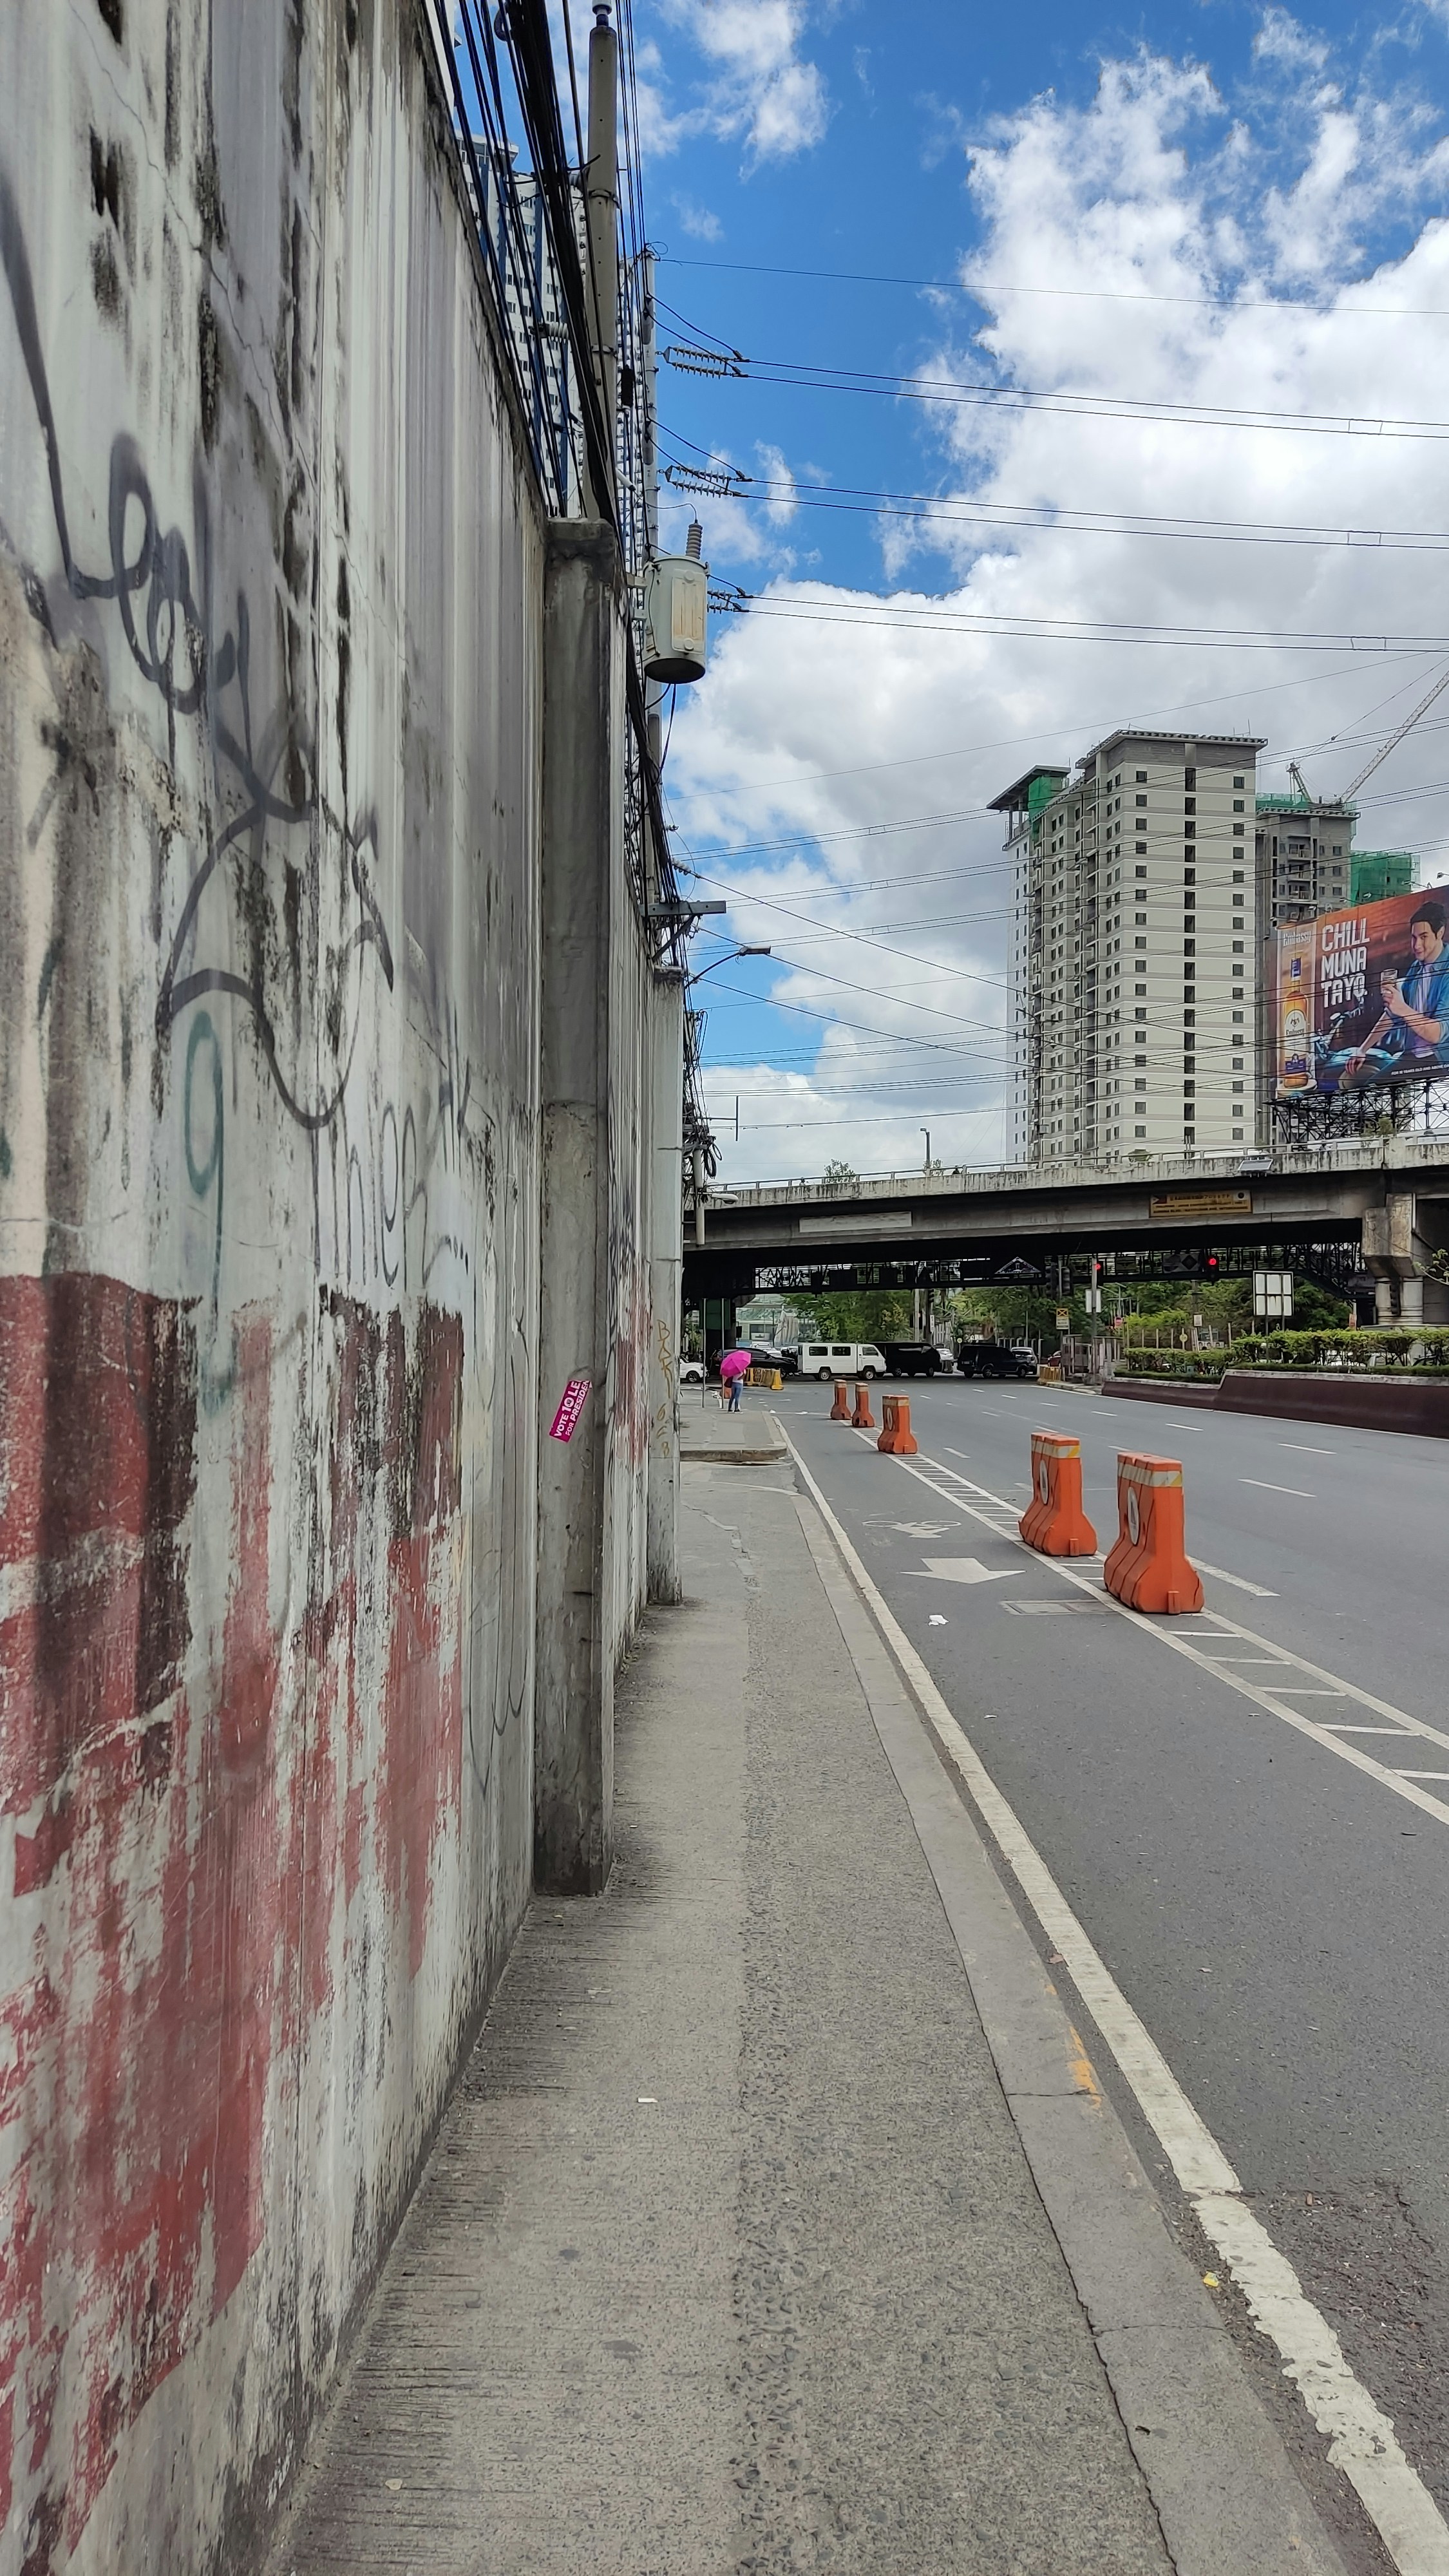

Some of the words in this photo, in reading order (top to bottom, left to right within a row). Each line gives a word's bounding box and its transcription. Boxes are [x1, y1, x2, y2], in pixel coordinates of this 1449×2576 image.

[1283, 930, 1311, 947] Embassy
[1321, 918, 1370, 951] CHILL
[1321, 946, 1367, 981] MUNA
[567, 1380, 582, 1397] LE
[562, 1397, 574, 1412] 10
[554, 1413, 569, 1437] VOTE
[565, 1422, 574, 1436] FOR
